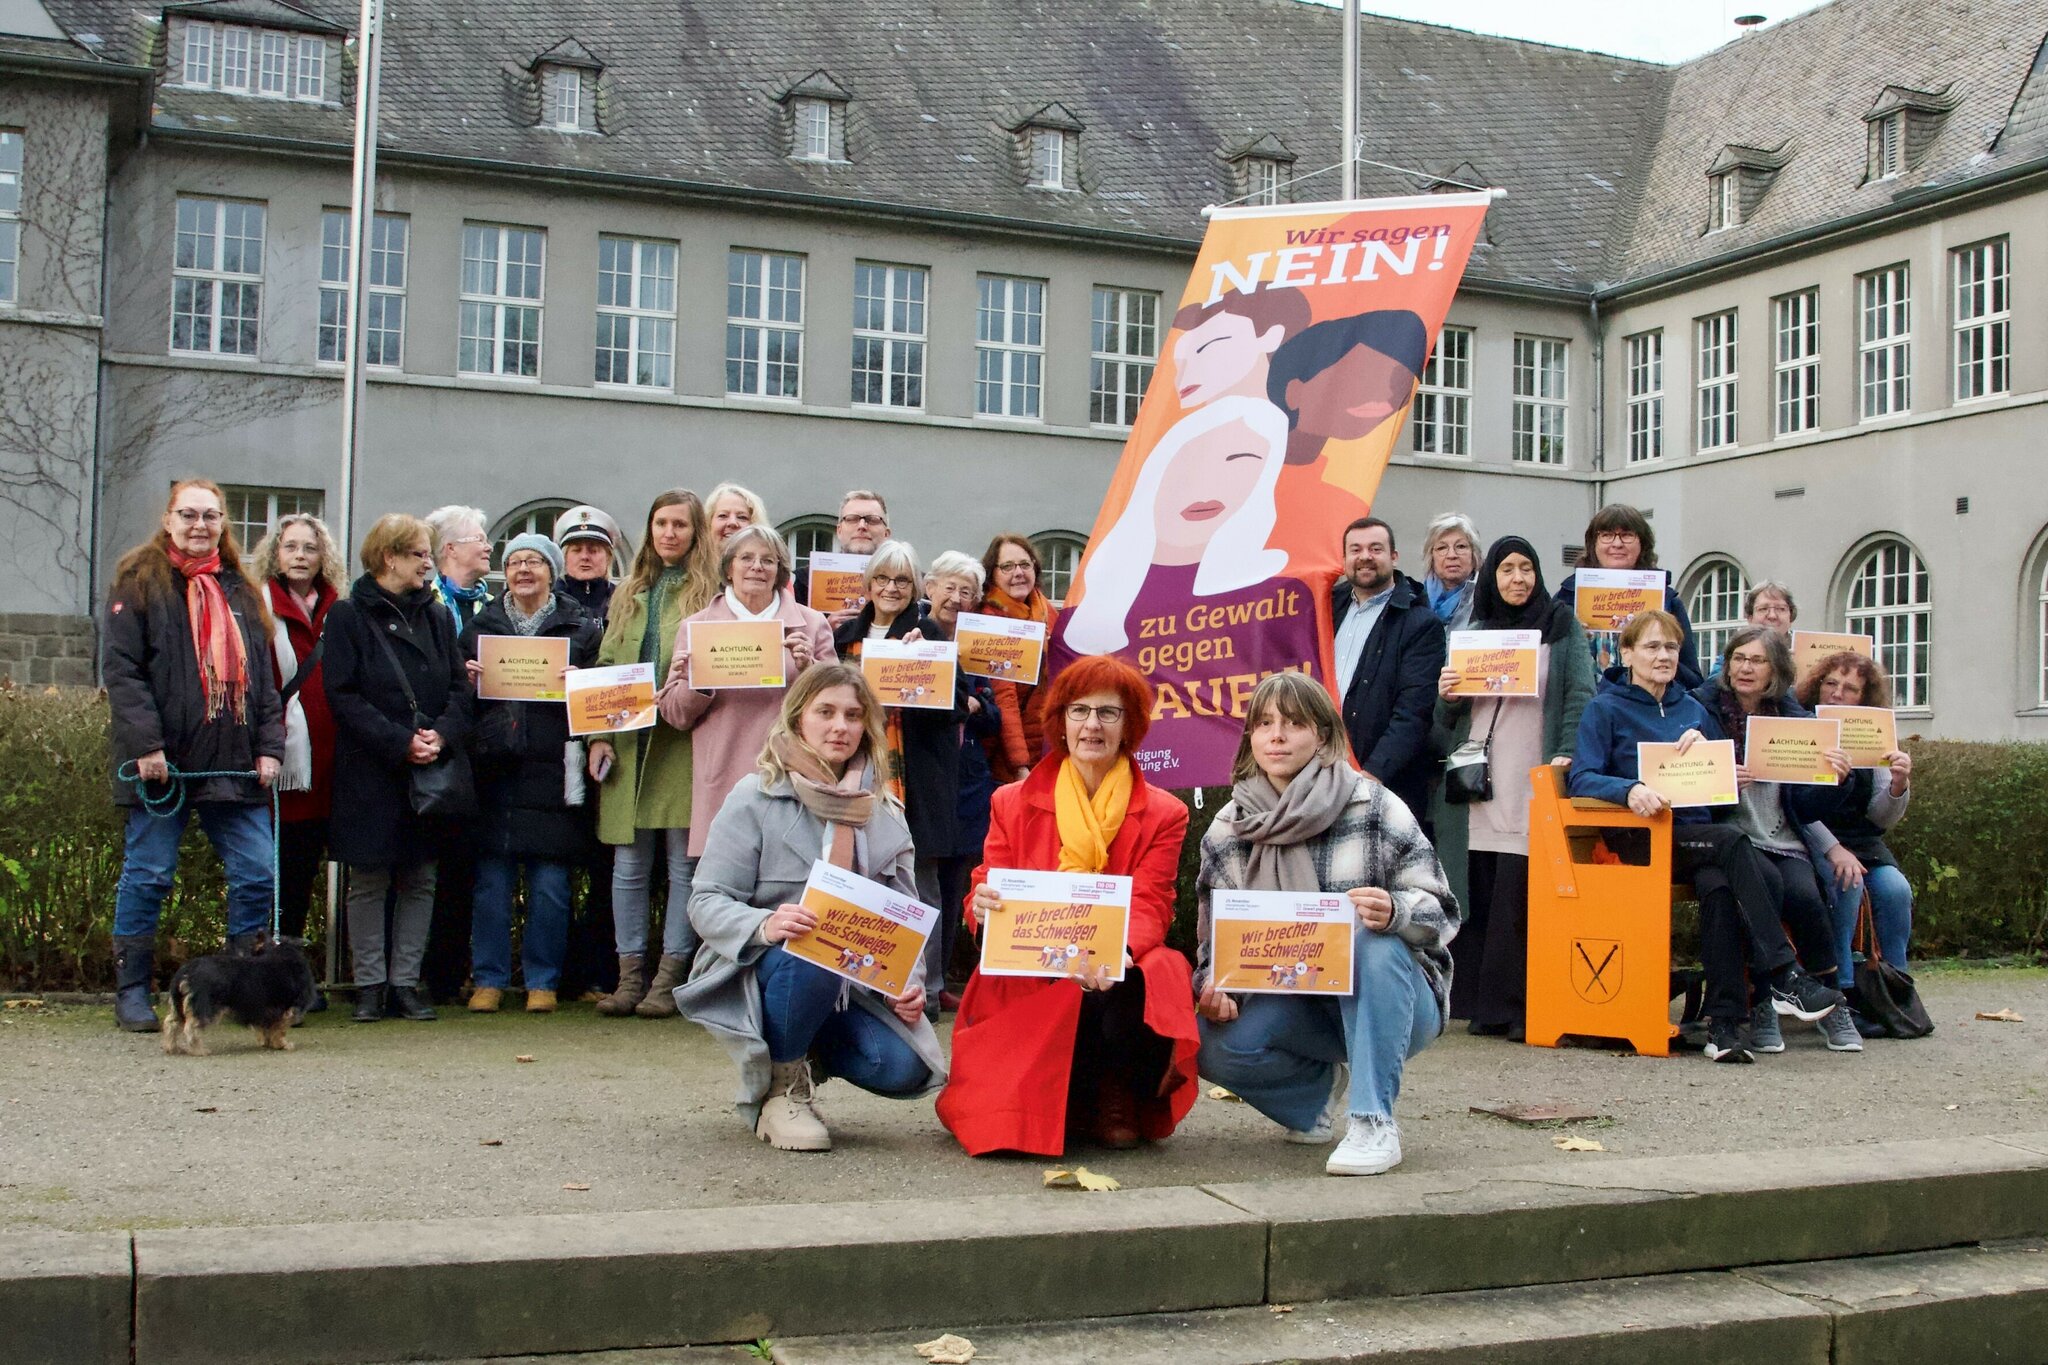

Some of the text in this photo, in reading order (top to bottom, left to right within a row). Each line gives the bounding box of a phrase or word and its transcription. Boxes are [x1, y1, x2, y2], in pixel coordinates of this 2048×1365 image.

[1286, 224, 1452, 246] Wir sagen
[1201, 230, 1451, 309] NEIN!
[841, 574, 864, 584] brech
[1593, 589, 1642, 602] Wir brechen
[1139, 588, 1299, 639] zu Gewalt
[1592, 599, 1646, 613] das Schweigen
[720, 645, 754, 653] ACHTUNG
[972, 636, 1022, 647] Wir brechen
[970, 647, 1024, 660] das Schweigen
[1138, 636, 1235, 676] gegen
[1466, 648, 1516, 665] Wir brechen
[881, 660, 932, 674] Wir brechen
[1465, 660, 1520, 675] das Schweigen
[879, 671, 936, 686] das Schweigen
[585, 683, 632, 704] Wir brechen
[585, 695, 638, 712] das Schweigen
[1776, 738, 1809, 746] ACHTUNG
[1133, 749, 1171, 762] tigung
[1138, 757, 1180, 772] ung e.V.
[1670, 760, 1704, 769] ACHTUNG
[826, 908, 849, 922] Wir
[848, 912, 899, 935] brechen
[1015, 903, 1092, 925] Wir brechen
[820, 921, 841, 936] das
[838, 927, 897, 958] Schweigen
[1012, 921, 1098, 944] das Schweigen
[1241, 922, 1318, 944] Wir brechen
[1240, 940, 1325, 962] das Schweigen
